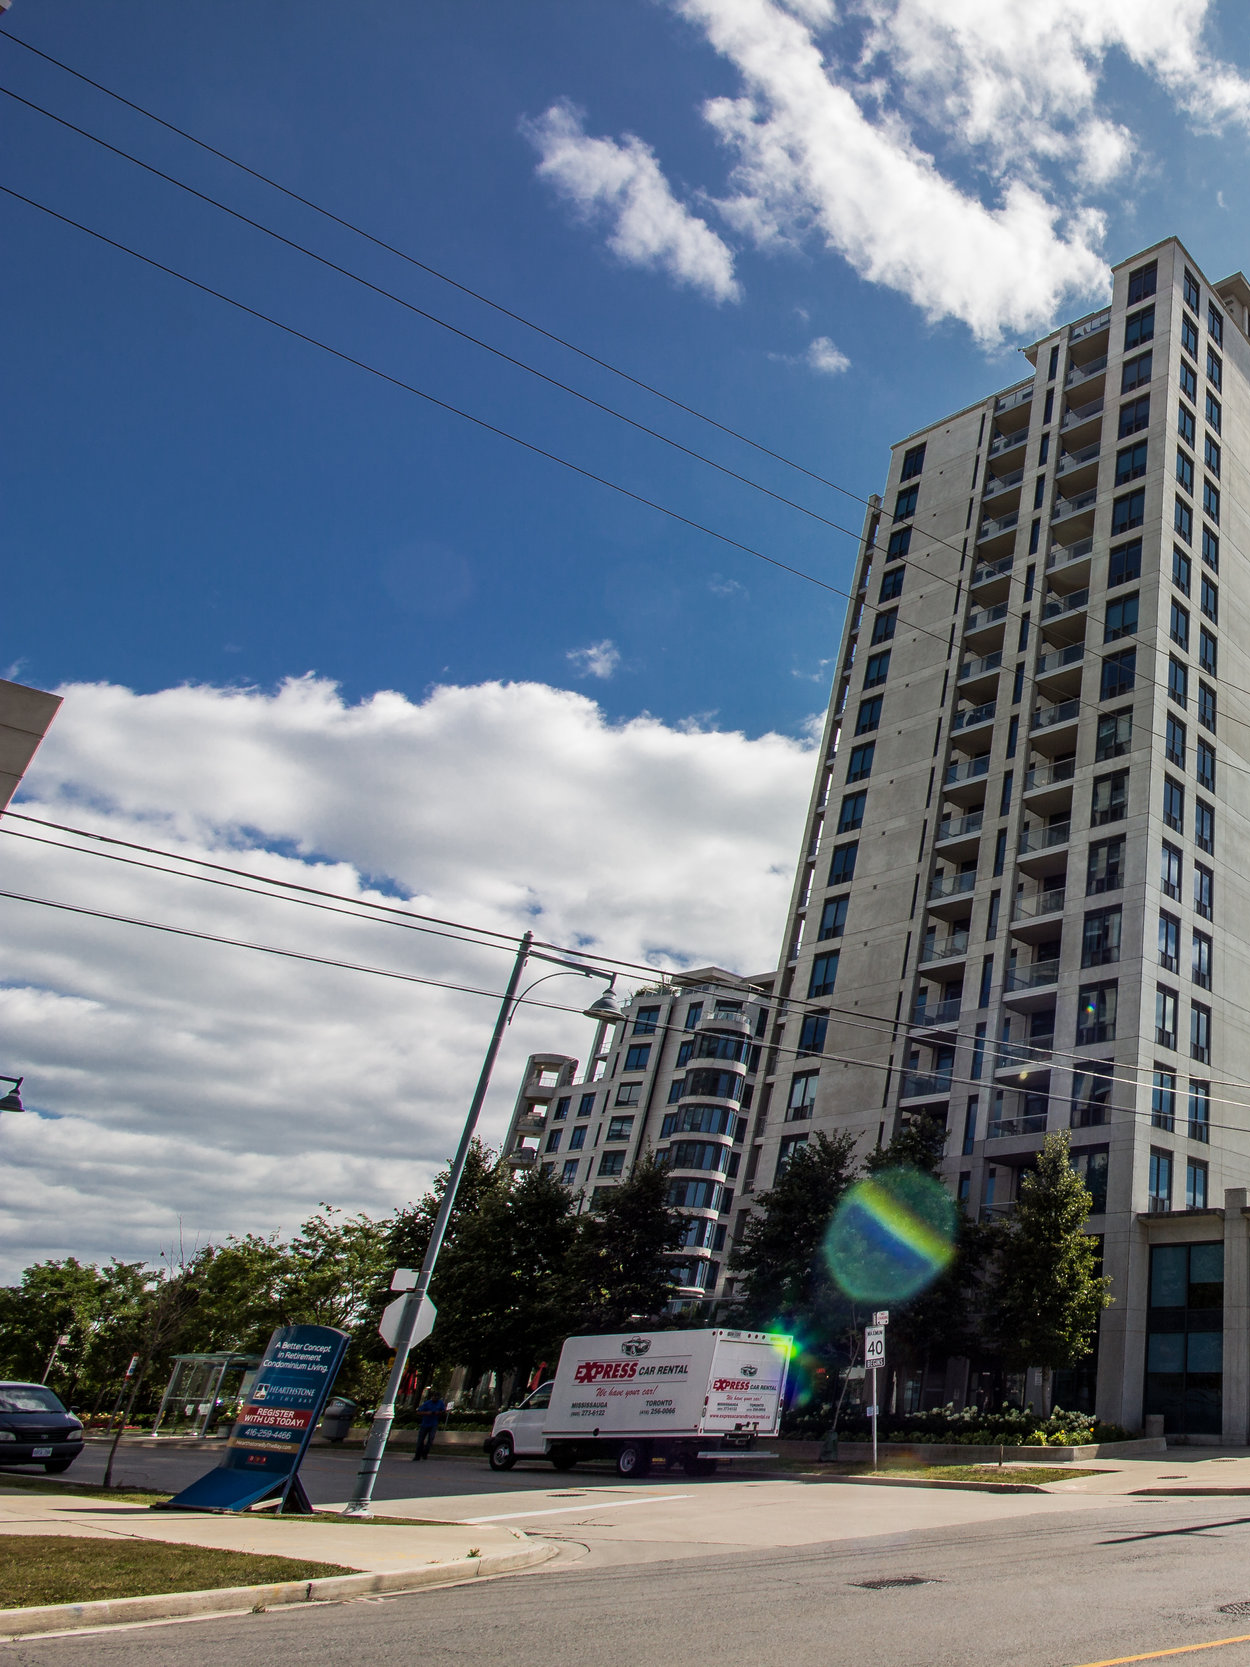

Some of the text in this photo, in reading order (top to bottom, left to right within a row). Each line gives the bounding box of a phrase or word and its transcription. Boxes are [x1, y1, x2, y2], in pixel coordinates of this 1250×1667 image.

[282, 1342, 303, 1350] Better
[304, 1343, 332, 1353] Concept
[868, 1340, 883, 1355] 40
[286, 1352, 321, 1361] Retirement
[263, 1360, 328, 1373] Condominium Living.
[867, 1359, 883, 1368] BEGINS
[574, 1362, 688, 1383] EXPRESS CAR RENTAL
[270, 1385, 316, 1397] HEARTHSTONE
[713, 1379, 750, 1391] EXPRESS
[596, 1385, 659, 1399] We have your car!
[257, 1408, 294, 1418] REGISTER
[244, 1415, 304, 1427] WITH US TODAY!
